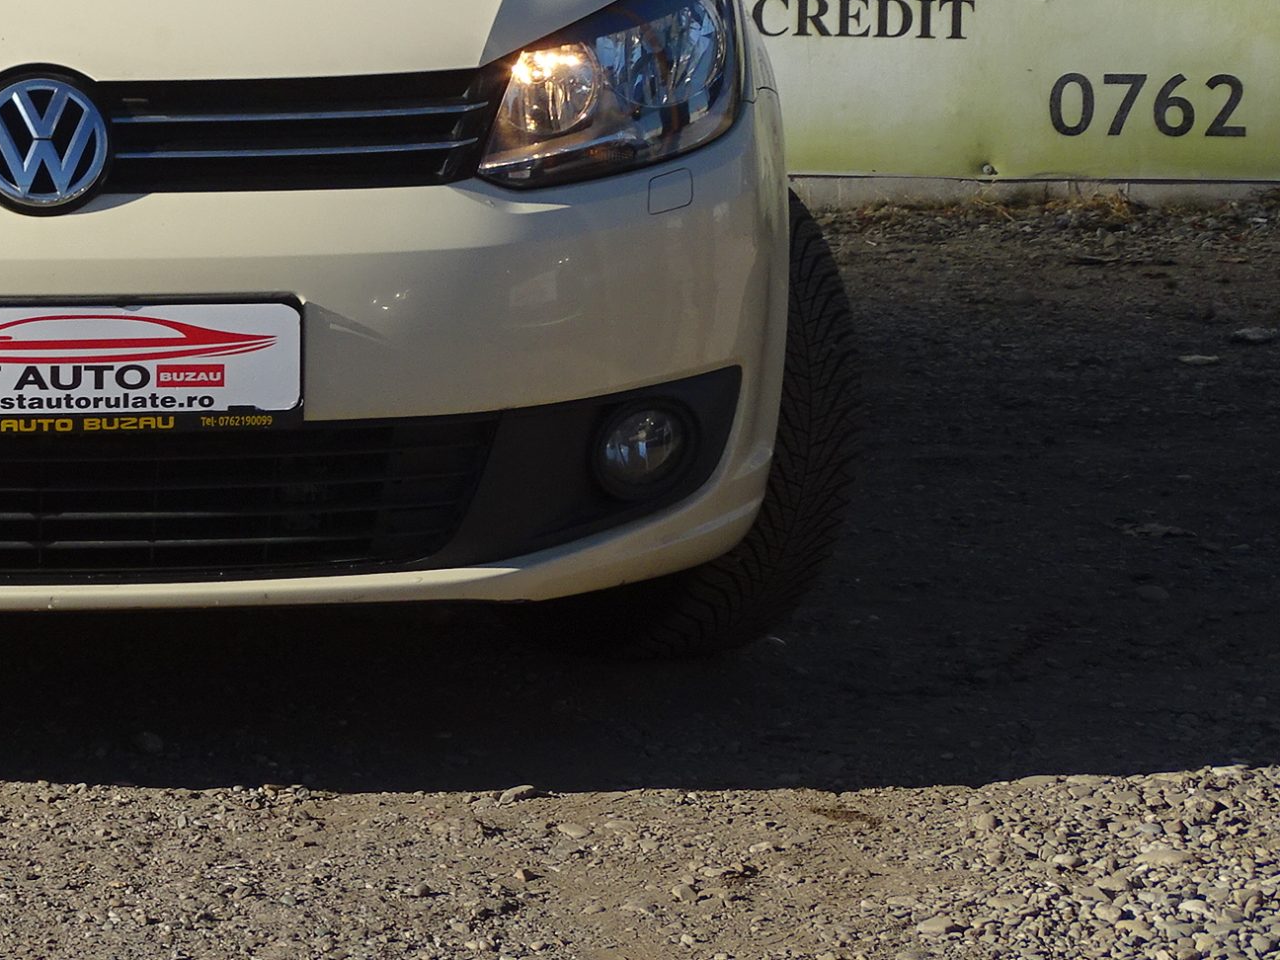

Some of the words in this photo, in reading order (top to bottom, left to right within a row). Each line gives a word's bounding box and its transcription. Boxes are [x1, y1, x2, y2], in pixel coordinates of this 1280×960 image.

[1048, 72, 1247, 138] 0762
[12, 364, 152, 391] AUTO
[159, 370, 222, 383] BUZAU
[0, 418, 73, 432] AUTO
[83, 416, 175, 431] BUZAU
[218, 415, 273, 427] 0762190099
